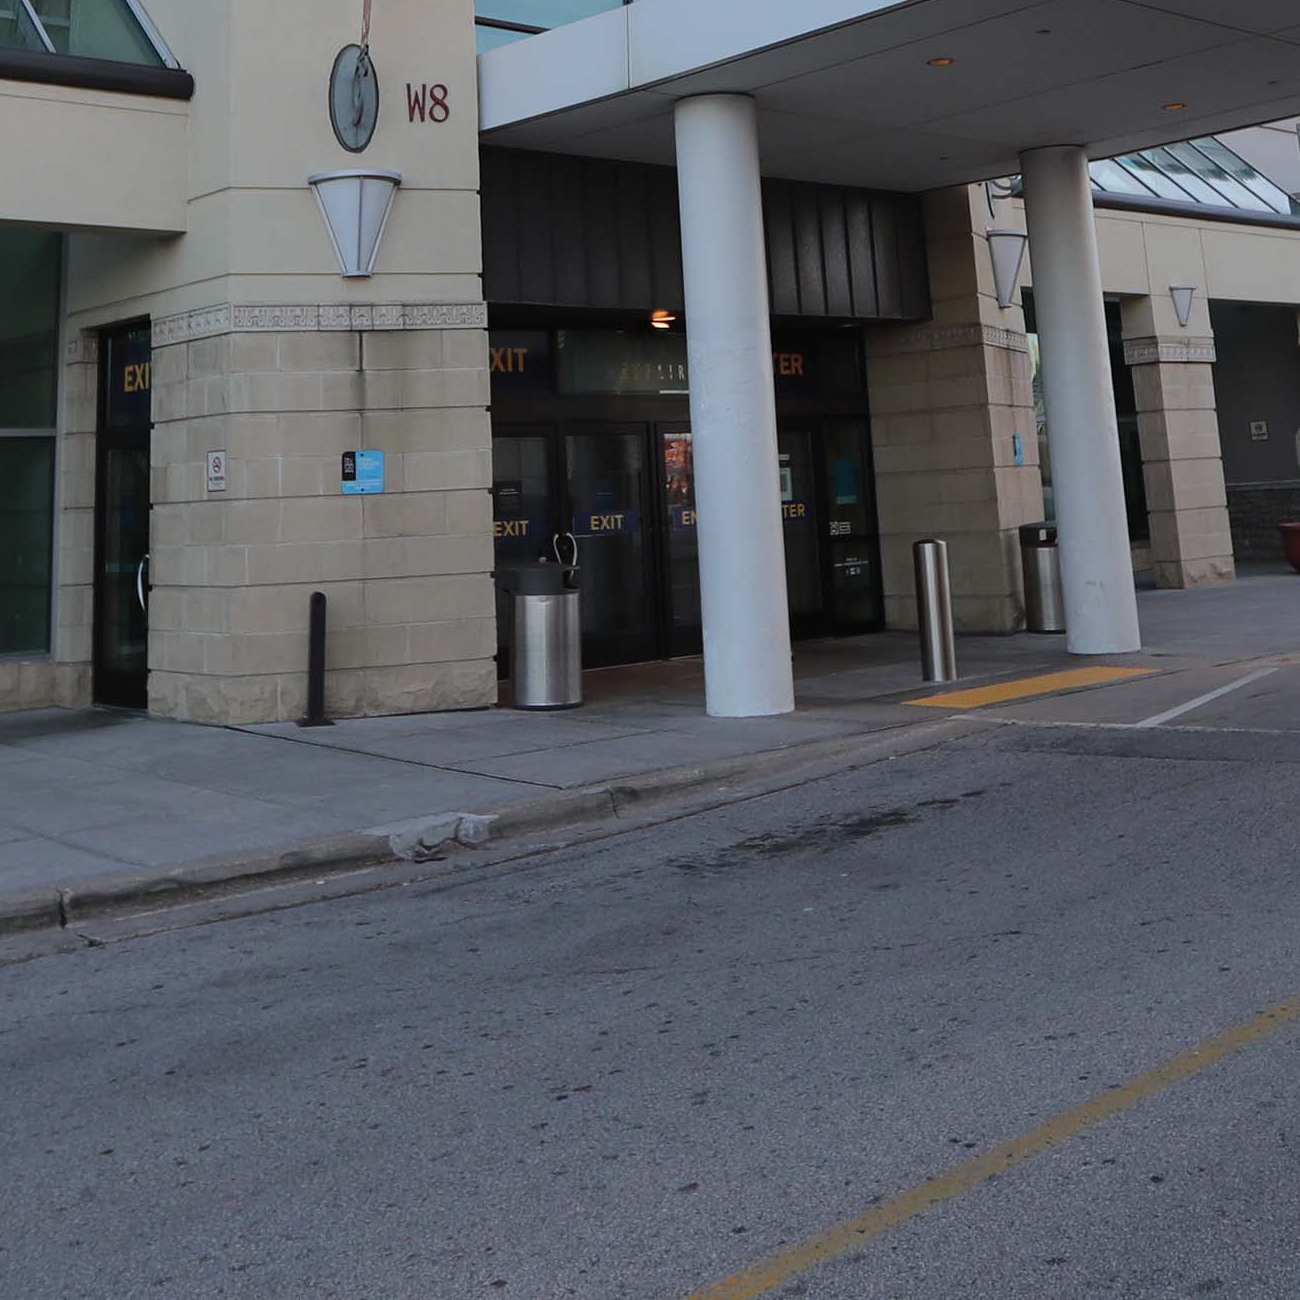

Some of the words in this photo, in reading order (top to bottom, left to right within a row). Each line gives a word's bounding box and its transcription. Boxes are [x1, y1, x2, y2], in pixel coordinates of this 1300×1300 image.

[406, 83, 449, 123] W8
[490, 347, 528, 373] XIT
[123, 362, 150, 393] EXI
[493, 519, 529, 537] EXIT
[590, 513, 625, 531] EXIT
